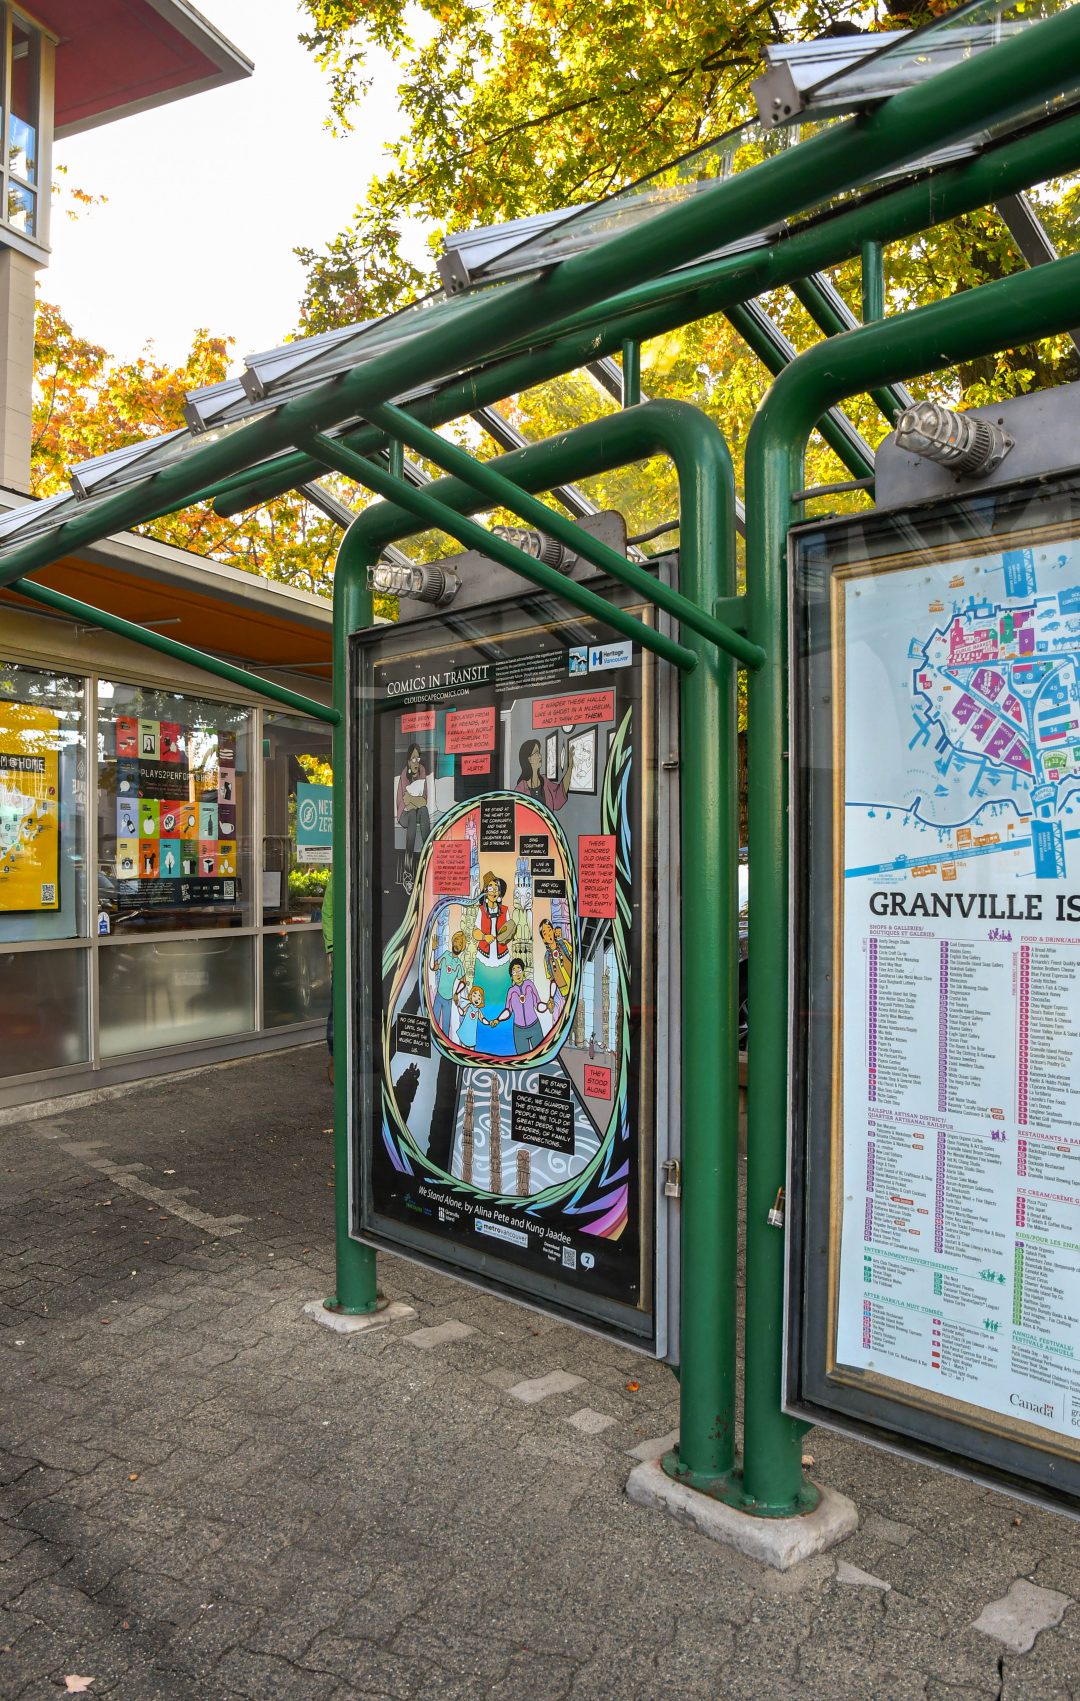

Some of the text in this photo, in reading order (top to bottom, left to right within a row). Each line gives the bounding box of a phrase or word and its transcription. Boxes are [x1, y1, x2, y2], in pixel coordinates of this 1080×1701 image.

[603, 650, 624, 658] Heritage
[604, 656, 629, 664] Vancouver
[387, 677, 426, 695] COMICS
[428, 674, 441, 688] IN
[443, 665, 490, 685] TRANSIT
[403, 688, 470, 705] CLOUDSCAPECOMICS.COM
[545, 700, 566, 708] WANDER
[587, 695, 607, 703] HALLS
[554, 707, 570, 715] GHOST
[0, 755, 45, 771] M@HOME
[869, 891, 1043, 920] GRANVILLE
[400, 1030, 420, 1038] BROUGHT
[590, 1069, 606, 1077] THEY
[549, 1080, 568, 1089] STAND
[587, 1078, 608, 1086] STOOD
[516, 1095, 534, 1104] ONCE,
[543, 1100, 570, 1110] GUARDED
[514, 1109, 538, 1119] PEOPLE.
[548, 1116, 562, 1124] TOLD
[526, 1104, 549, 1115] STORIES
[559, 1111, 571, 1119] OUR
[868, 1107, 946, 1123] RAILSPUR ARTISAN DISTRICT/
[516, 1118, 569, 1134] GREAT DEEDS, WISE
[868, 1112, 954, 1130] QUARTIER ARTISANAL RAILSPUR
[514, 1124, 541, 1136] LEADERS,
[551, 1133, 571, 1142] FAMILY
[1017, 1130, 1062, 1142] RESTAURANTS
[418, 1185, 427, 1196] We
[427, 1188, 444, 1203] Stand
[444, 1196, 463, 1211] Alone,
[464, 1201, 473, 1214] by
[473, 1205, 492, 1218] Alina
[493, 1210, 510, 1224] Pete
[510, 1216, 524, 1228] and
[525, 1220, 545, 1237] Kung
[545, 1227, 572, 1245] Jaadee
[483, 1223, 527, 1242] metrovancouver
[1015, 1231, 1048, 1243] KIDS/POUR
[585, 1256, 590, 1264] 7
[864, 1291, 880, 1299] AFTER
[881, 1295, 905, 1307] DARK/LA
[906, 1302, 920, 1310] NUIT
[1012, 1329, 1038, 1341] ANNUAL
[1012, 1335, 1074, 1357] FESTIVALS ANNUELS
[1009, 1393, 1054, 1418] Canada
